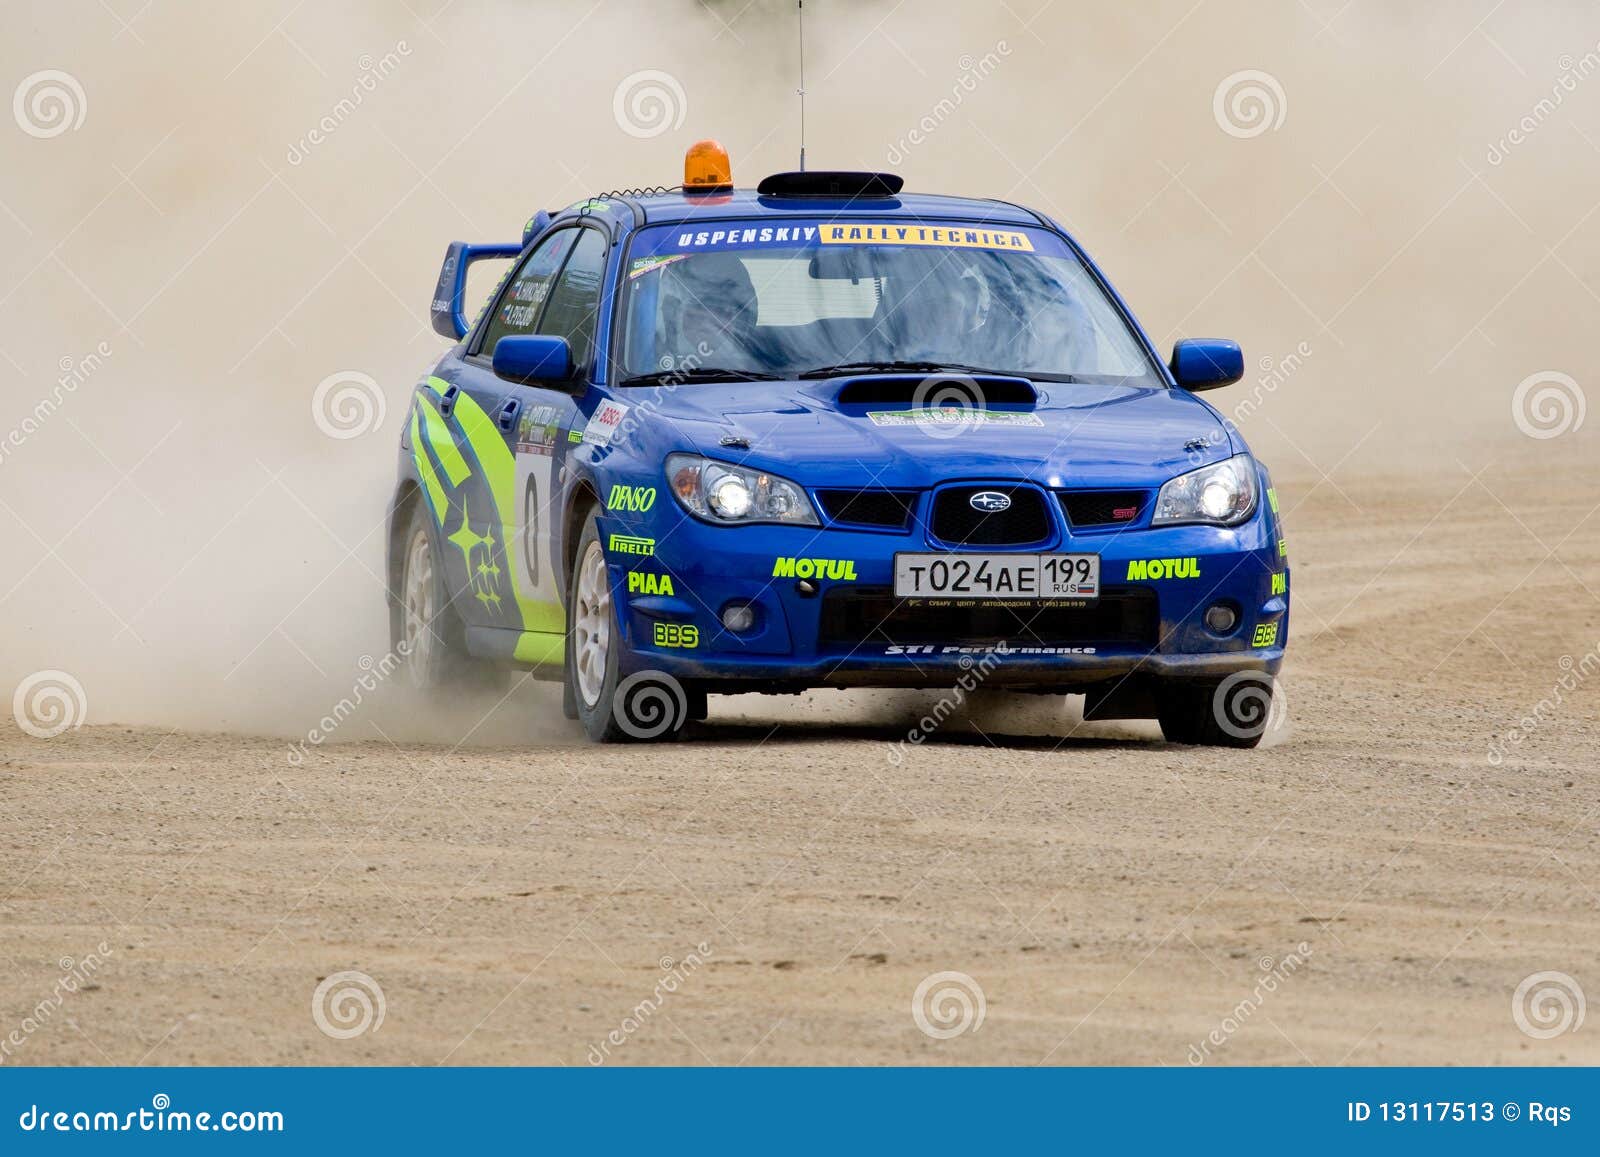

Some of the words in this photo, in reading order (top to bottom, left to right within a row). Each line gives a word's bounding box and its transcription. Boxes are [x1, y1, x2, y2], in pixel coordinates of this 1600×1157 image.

[678, 227, 816, 247] USPENSKIY
[831, 227, 908, 240] RALLY
[917, 228, 1023, 247] TECNICA
[607, 484, 656, 512] DENSO
[524, 471, 539, 588] 0
[609, 533, 656, 557] PIRELLI
[772, 557, 858, 580] MOTUL
[909, 560, 1035, 592] T024AE
[1044, 558, 1091, 583] 199
[1127, 557, 1201, 580] MOTUL
[628, 571, 674, 596] PIAA
[1053, 584, 1077, 593] RUS
[654, 622, 700, 648] BBS
[885, 645, 936, 655] STI
[942, 644, 1096, 655] Performance
